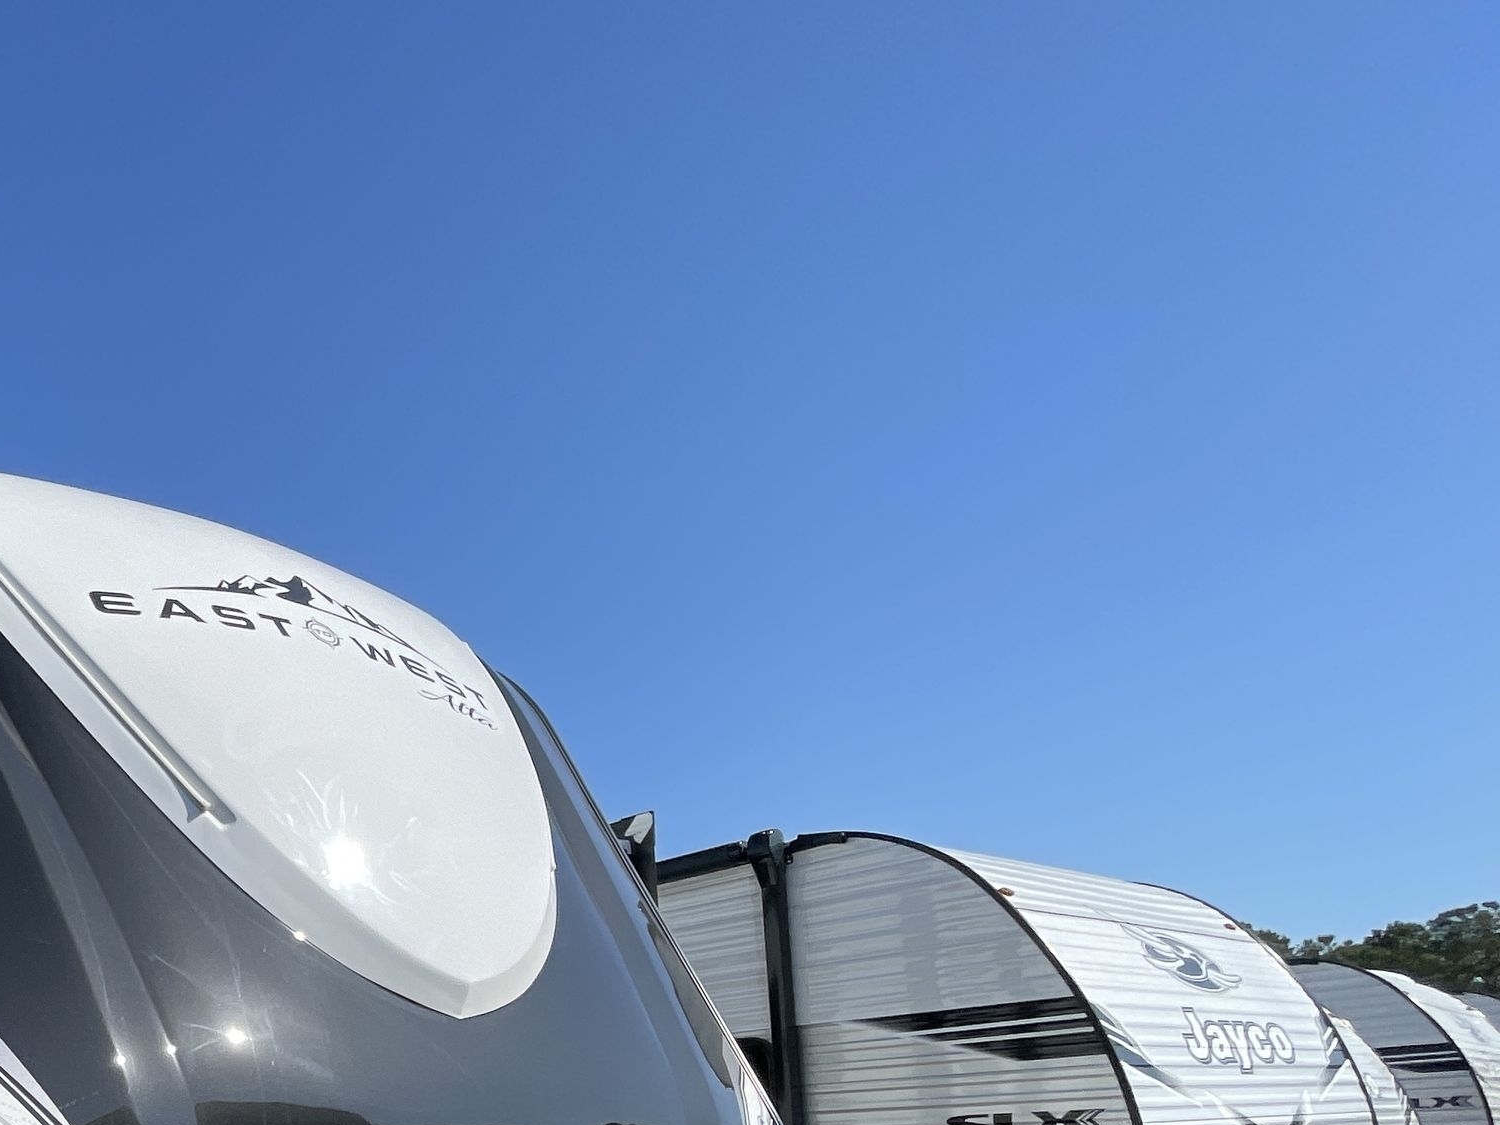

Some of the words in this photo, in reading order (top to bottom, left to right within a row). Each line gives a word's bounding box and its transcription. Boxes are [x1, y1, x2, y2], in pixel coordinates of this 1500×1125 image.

[88, 590, 292, 639] EAST
[349, 635, 488, 710] WEST
[417, 689, 498, 731] Alta
[1181, 1006, 1296, 1075] Jayco
[1406, 1094, 1474, 1109] LX
